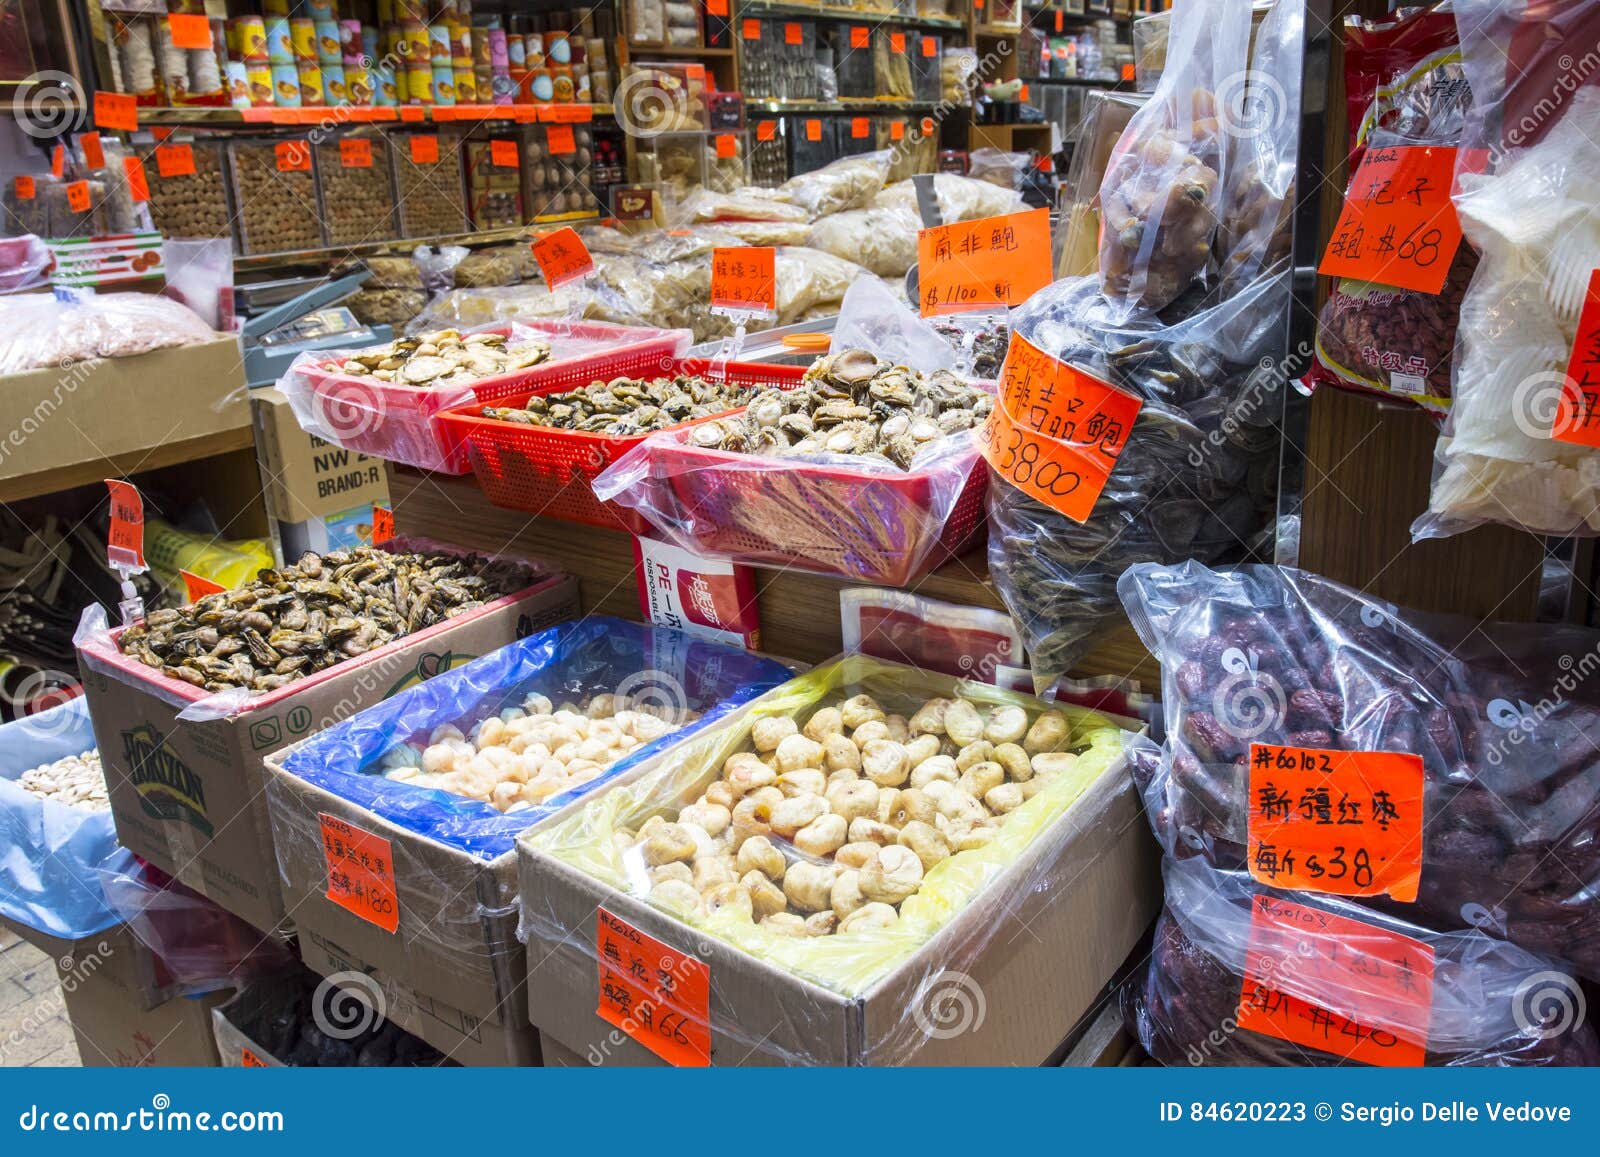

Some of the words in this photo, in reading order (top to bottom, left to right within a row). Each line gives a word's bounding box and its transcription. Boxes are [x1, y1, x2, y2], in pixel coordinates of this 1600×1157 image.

[1362, 346, 1428, 377] 特级品
[313, 449, 349, 473] NW
[646, 558, 661, 621] DISPOSABLE
[1254, 748, 1334, 773] #60102
